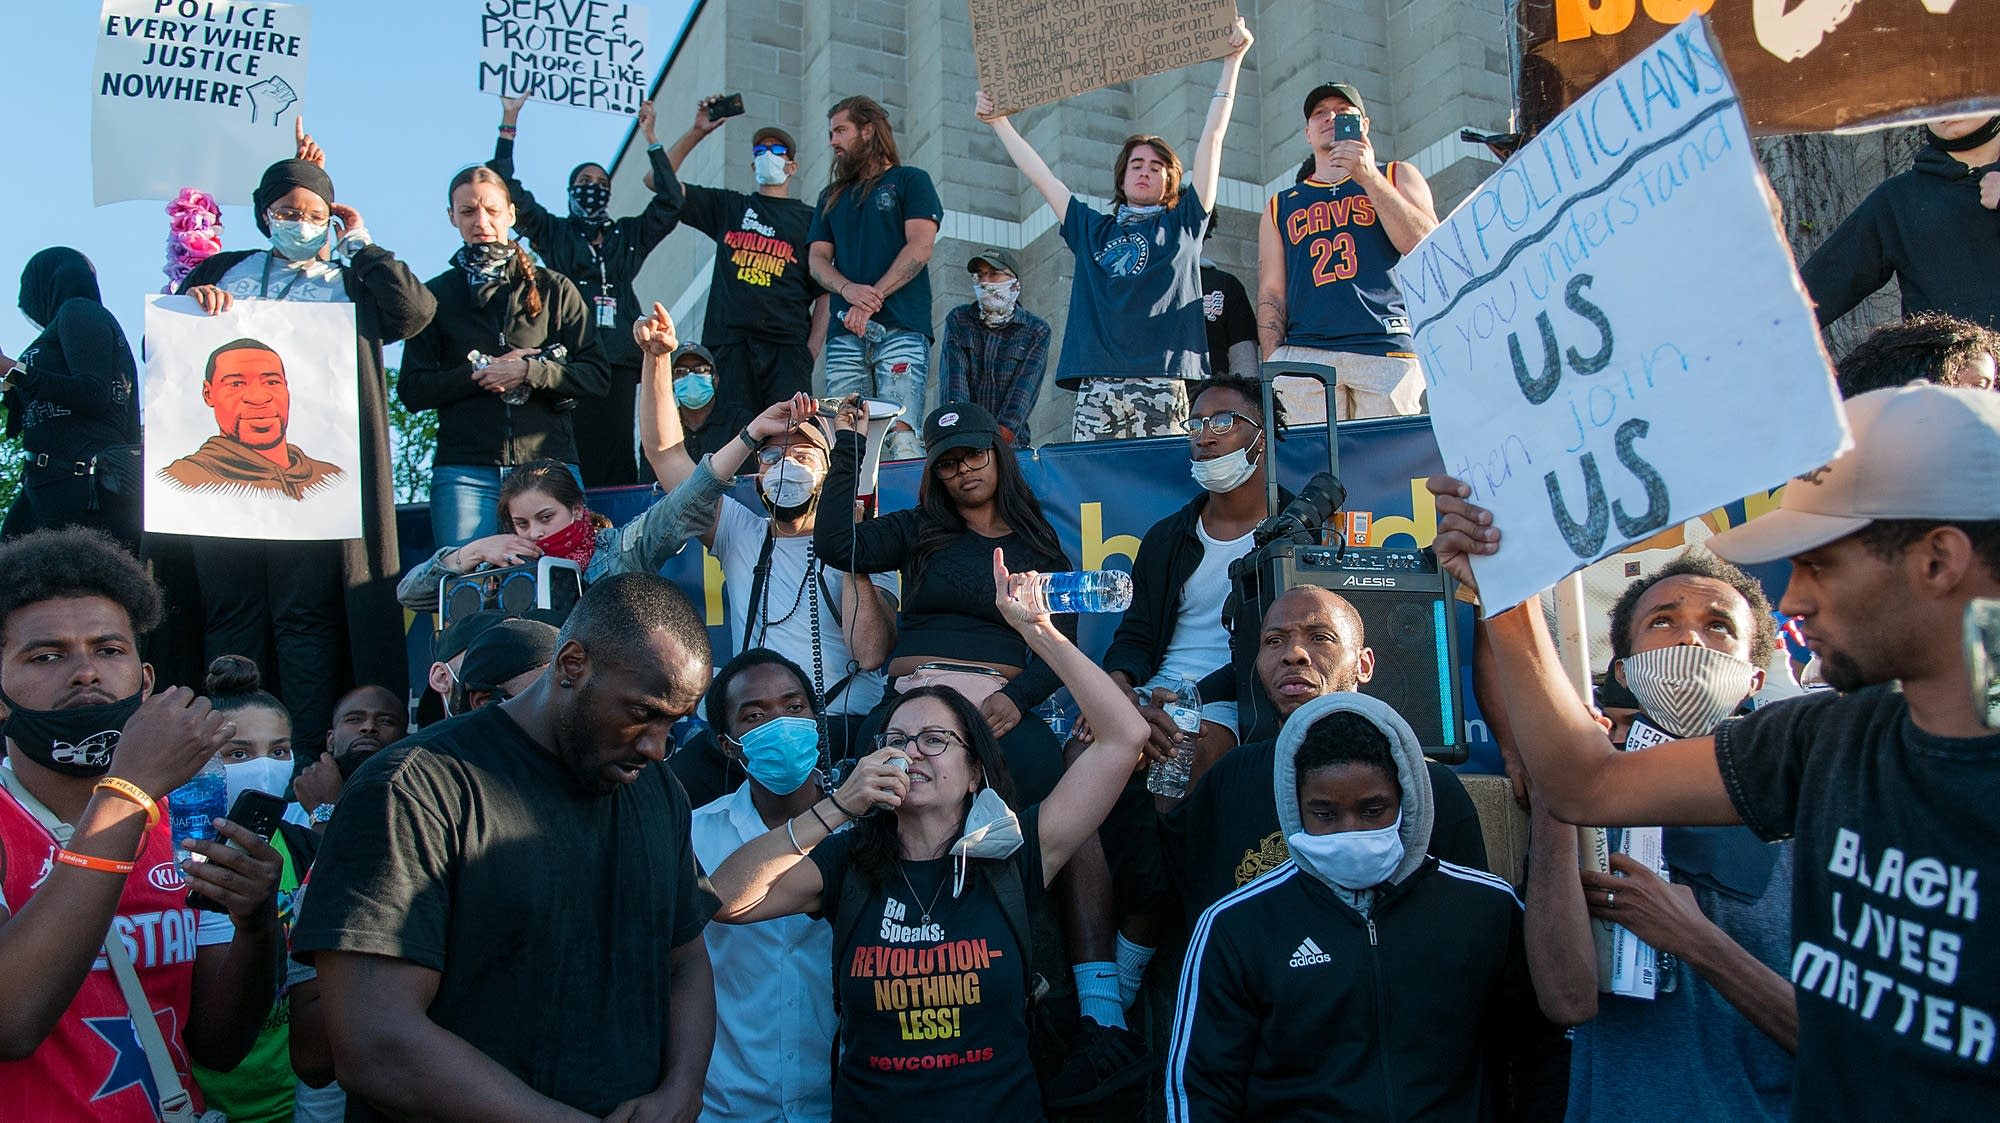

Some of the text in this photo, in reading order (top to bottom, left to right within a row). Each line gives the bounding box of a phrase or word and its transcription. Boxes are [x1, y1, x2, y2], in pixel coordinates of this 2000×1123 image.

[154, 0, 276, 29] POLICE
[486, 0, 608, 34] SERVE
[1097, 1, 1136, 21] Tamir
[481, 14, 644, 70] PROTECT?
[142, 43, 261, 76] JUSTICE
[101, 72, 243, 107] NOWHERE
[1472, 24, 1725, 262] POLITICIANS
[1286, 194, 1376, 245] CAVS
[731, 249, 786, 278] NOTHING
[1310, 232, 1358, 288] 23
[234, 279, 319, 298] BLAK
[737, 267, 771, 288] LESS!
[1507, 273, 1614, 405] US
[1544, 418, 1670, 559] US
[1343, 575, 1396, 587] ALESIS
[884, 897, 906, 922] BA
[1832, 891, 1963, 986] LIVES
[1289, 953, 1332, 968] adidas
[1643, 969, 1653, 986] STOP
[874, 972, 981, 1011] NOTHING
[1791, 941, 1997, 1066] MATTER
[898, 1007, 961, 1041] LESS!
[869, 1047, 994, 1071] revcom.us
